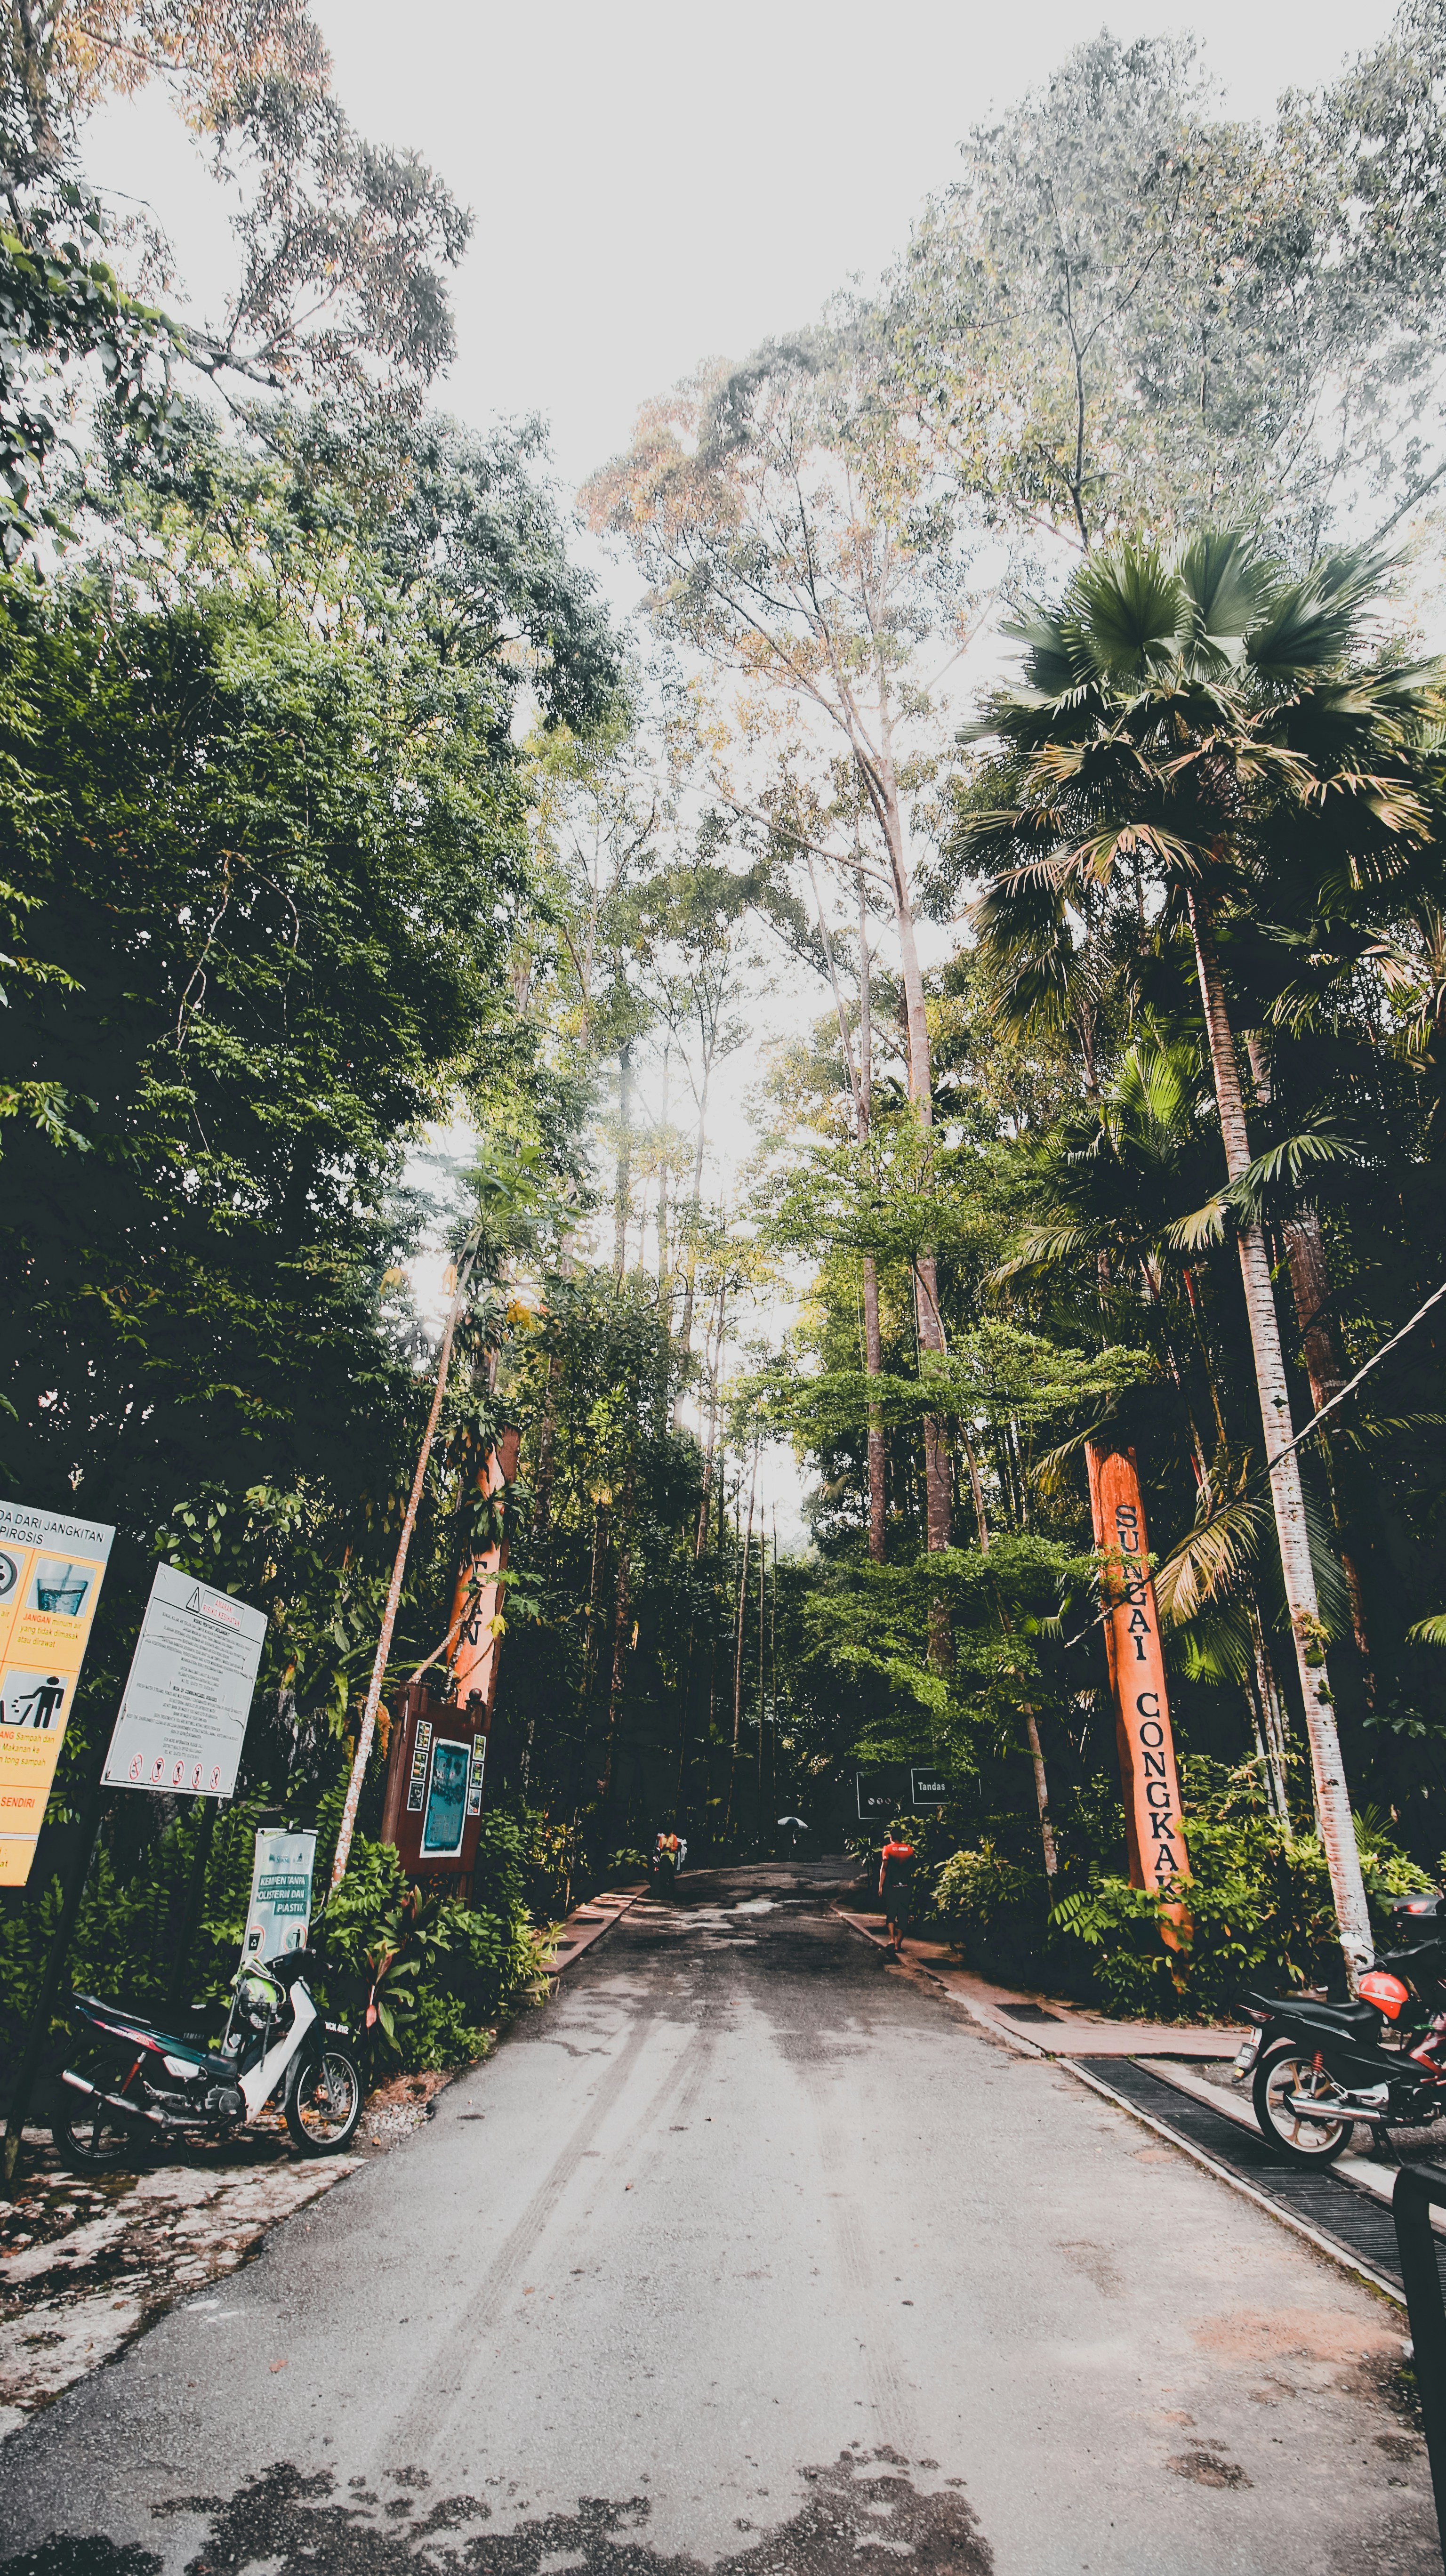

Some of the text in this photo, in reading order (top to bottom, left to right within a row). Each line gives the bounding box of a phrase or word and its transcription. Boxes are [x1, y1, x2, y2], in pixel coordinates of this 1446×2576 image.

[0, 1526, 44, 1544] PIROSIS
[15, 1514, 42, 1529] DARI
[44, 1520, 104, 1542] JANGKITAN
[215, 1599, 233, 1613] AMARAN
[23, 1613, 51, 1624] JANGAN
[52, 1618, 72, 1627] minum
[203, 1604, 240, 1626] RISIKO KESIHATAN
[20, 1626, 79, 1640] yang tidak dimasak
[32, 1638, 56, 1648] dirawat
[1115, 1505, 1181, 1904] SUNGAI CONGKAK
[16, 1732, 41, 1743] Sampah
[43, 1735, 55, 1743] dan
[2, 1743, 40, 1754] Makanan ke
[4, 1756, 19, 1766] tong
[21, 1758, 46, 1767] sampah
[918, 1782, 945, 1791] Tandas
[0, 1796, 35, 1808] SENDIRI
